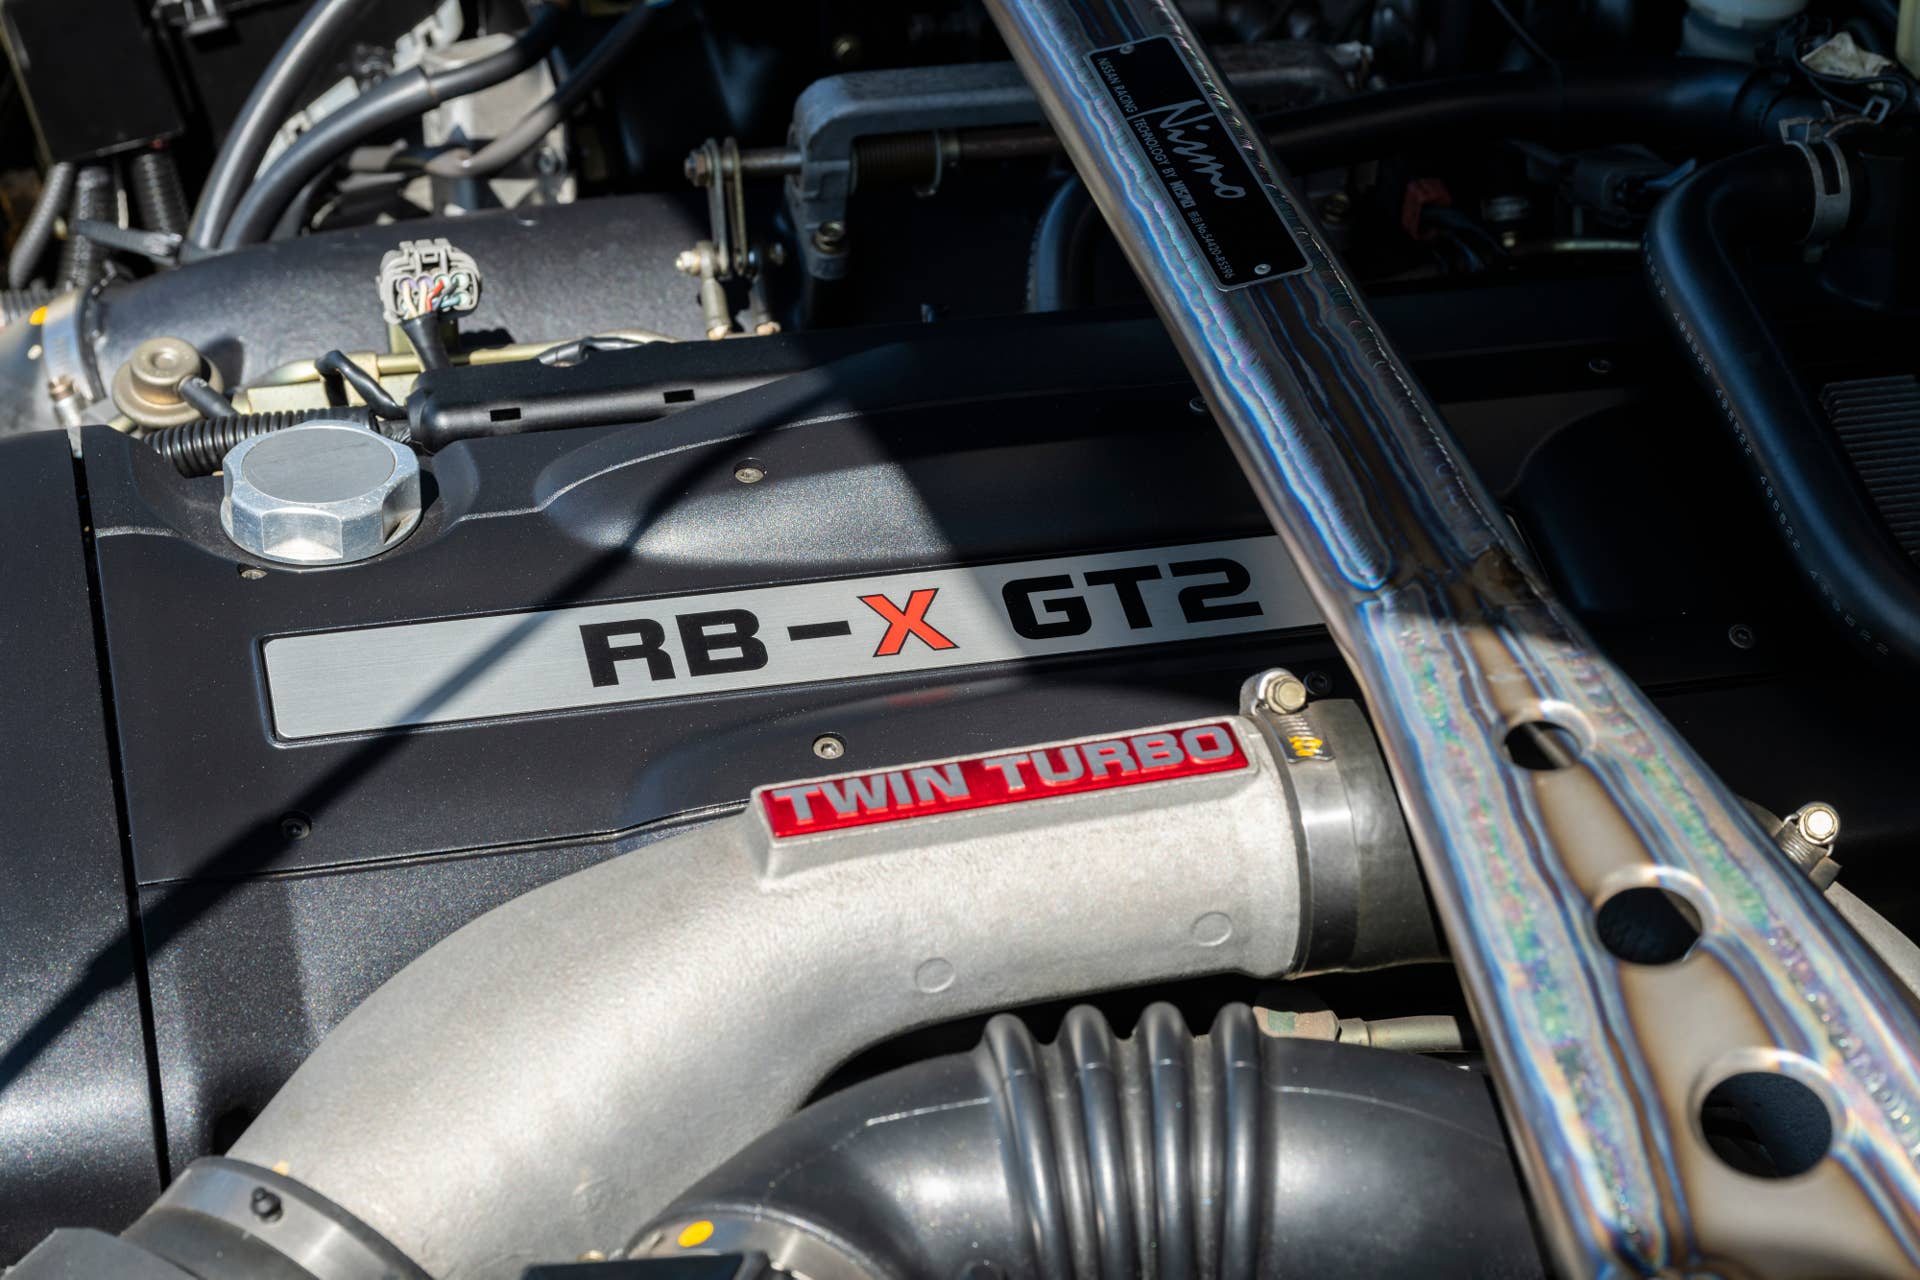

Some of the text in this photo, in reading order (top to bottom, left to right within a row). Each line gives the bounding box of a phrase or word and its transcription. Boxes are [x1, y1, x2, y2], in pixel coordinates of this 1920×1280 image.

[1098, 57, 1120, 85] NISSAN
[1113, 83, 1138, 114] RACING
[1133, 117, 1168, 167] TECHNOLOGY
[1163, 167, 1178, 180] BY
[579, 557, 1265, 688] RB-X GT2
[772, 724, 1235, 824] TWIN TURBO
